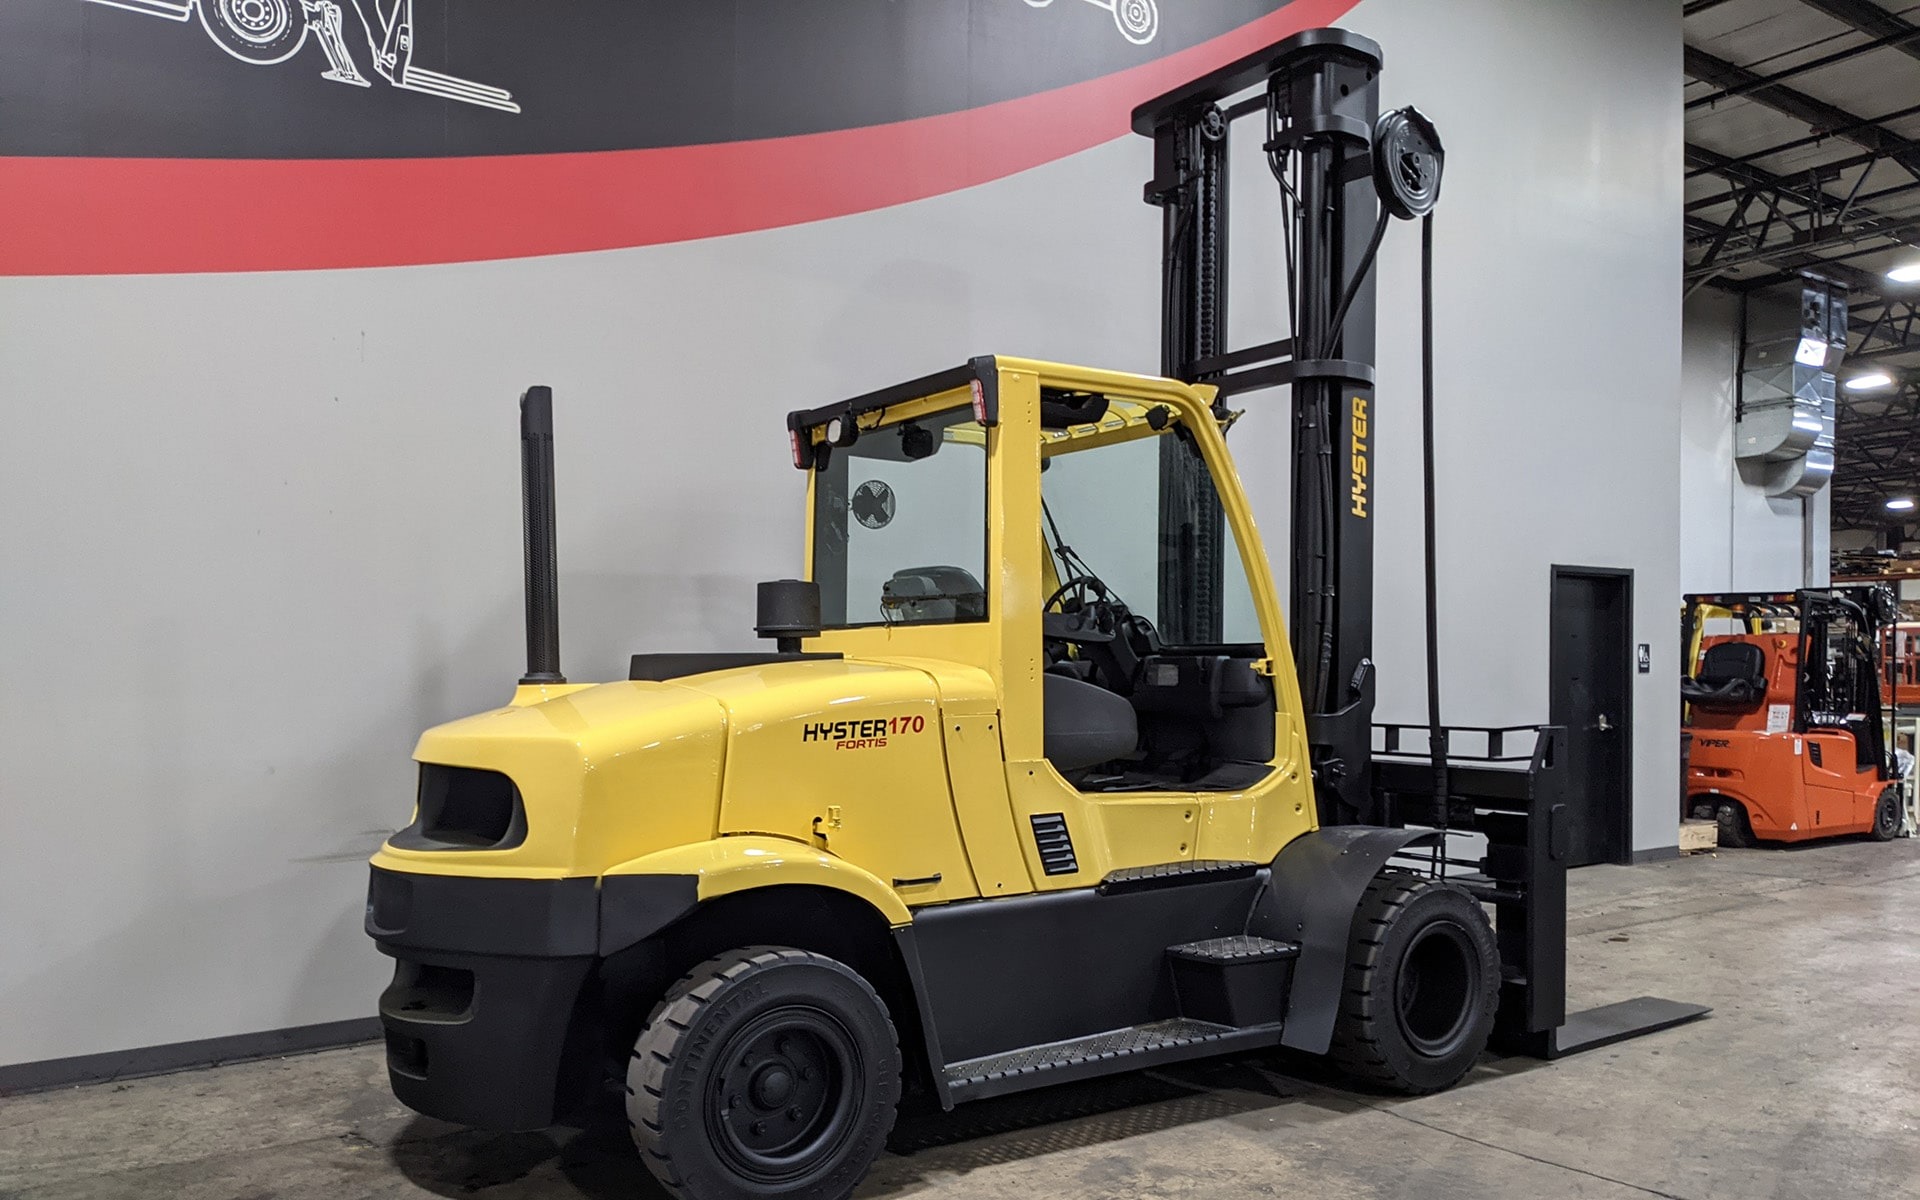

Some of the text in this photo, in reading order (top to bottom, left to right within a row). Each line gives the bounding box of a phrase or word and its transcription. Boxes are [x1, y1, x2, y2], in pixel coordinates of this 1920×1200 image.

[1352, 397, 1367, 518] HYSTER
[803, 715, 925, 742] HYSTER 170
[836, 737, 888, 751] FORTIS
[1700, 738, 1730, 748] VIPER
